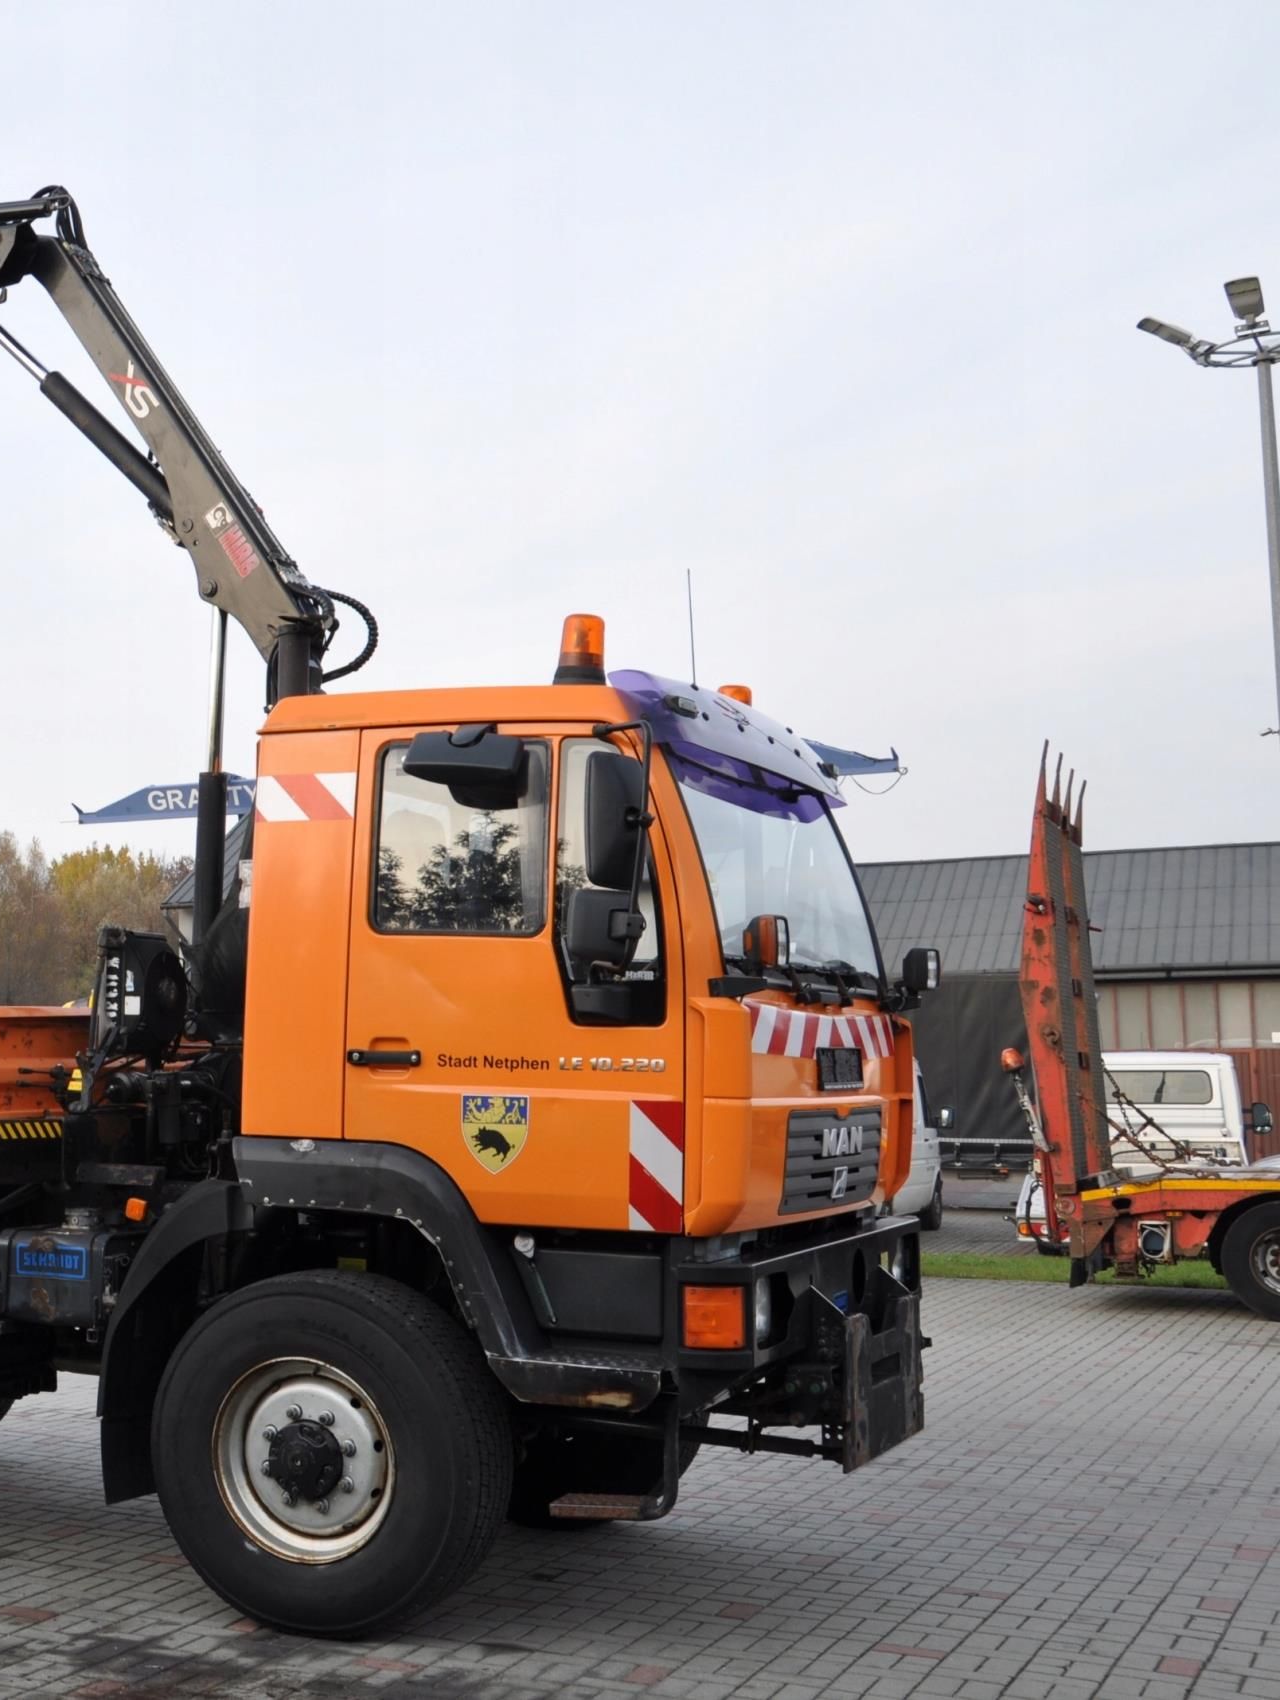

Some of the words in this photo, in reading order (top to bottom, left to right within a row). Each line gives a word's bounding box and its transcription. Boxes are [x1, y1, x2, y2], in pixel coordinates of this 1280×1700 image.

[147, 784, 257, 811] GRATY
[436, 1053, 478, 1069] Stadt
[483, 1055, 550, 1072] Netphen
[558, 1056, 583, 1071] LE
[589, 1056, 665, 1073] 10.220
[822, 1126, 863, 1158] MAN
